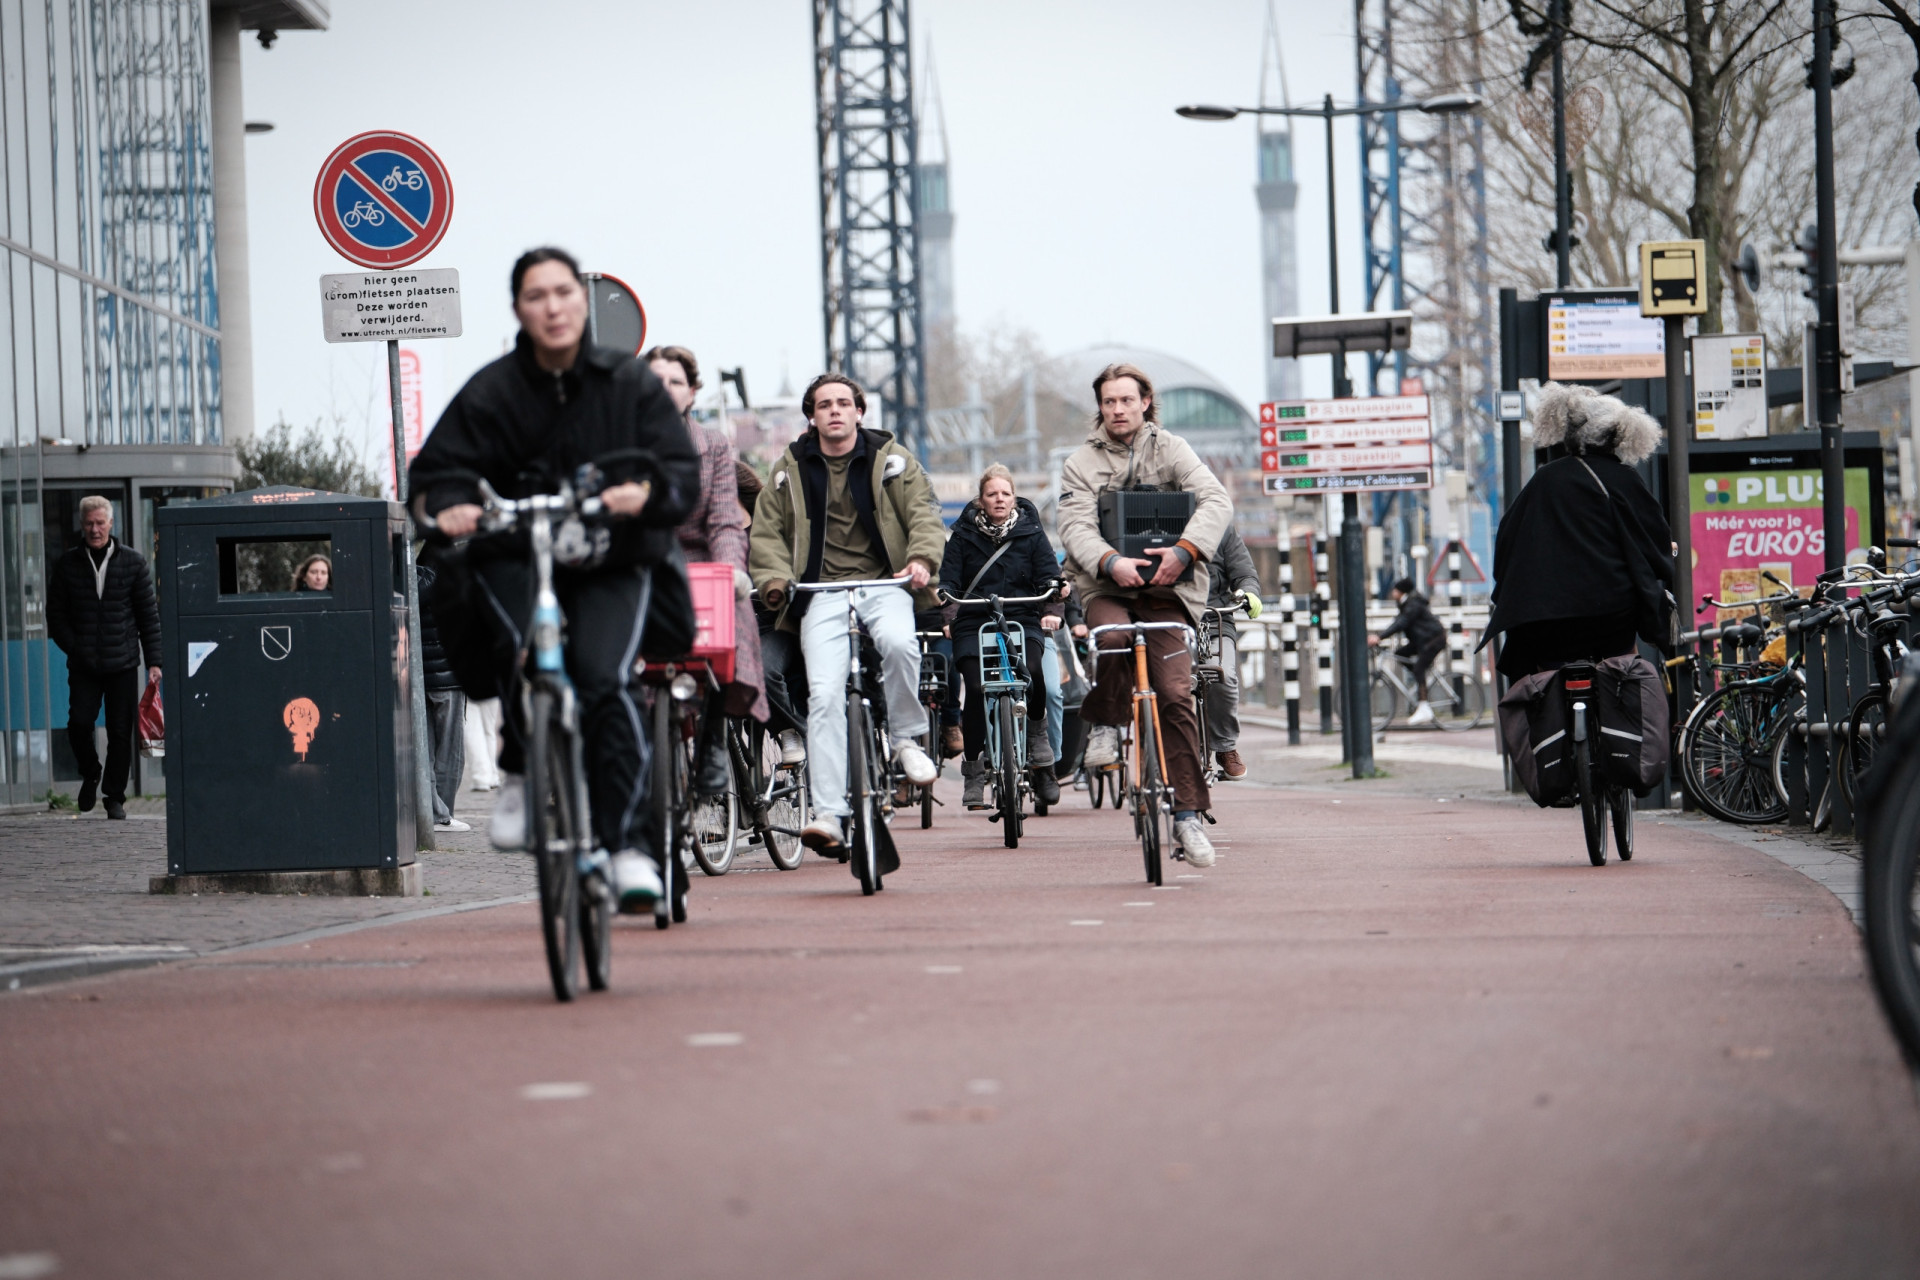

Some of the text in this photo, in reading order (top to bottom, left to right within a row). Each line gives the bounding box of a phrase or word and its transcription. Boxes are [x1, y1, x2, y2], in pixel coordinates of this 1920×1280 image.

[364, 275, 417, 286] hier geen
[406, 286, 459, 298] plaatsen.
[356, 300, 428, 312] Deze worden
[360, 313, 424, 326] verwijderd.
[340, 326, 447, 338] www.utrecht.nl/fietsweg
[1736, 475, 1823, 505] PLU
[1705, 514, 1802, 531] Méér voor je
[1727, 525, 1824, 558] EURO'S
